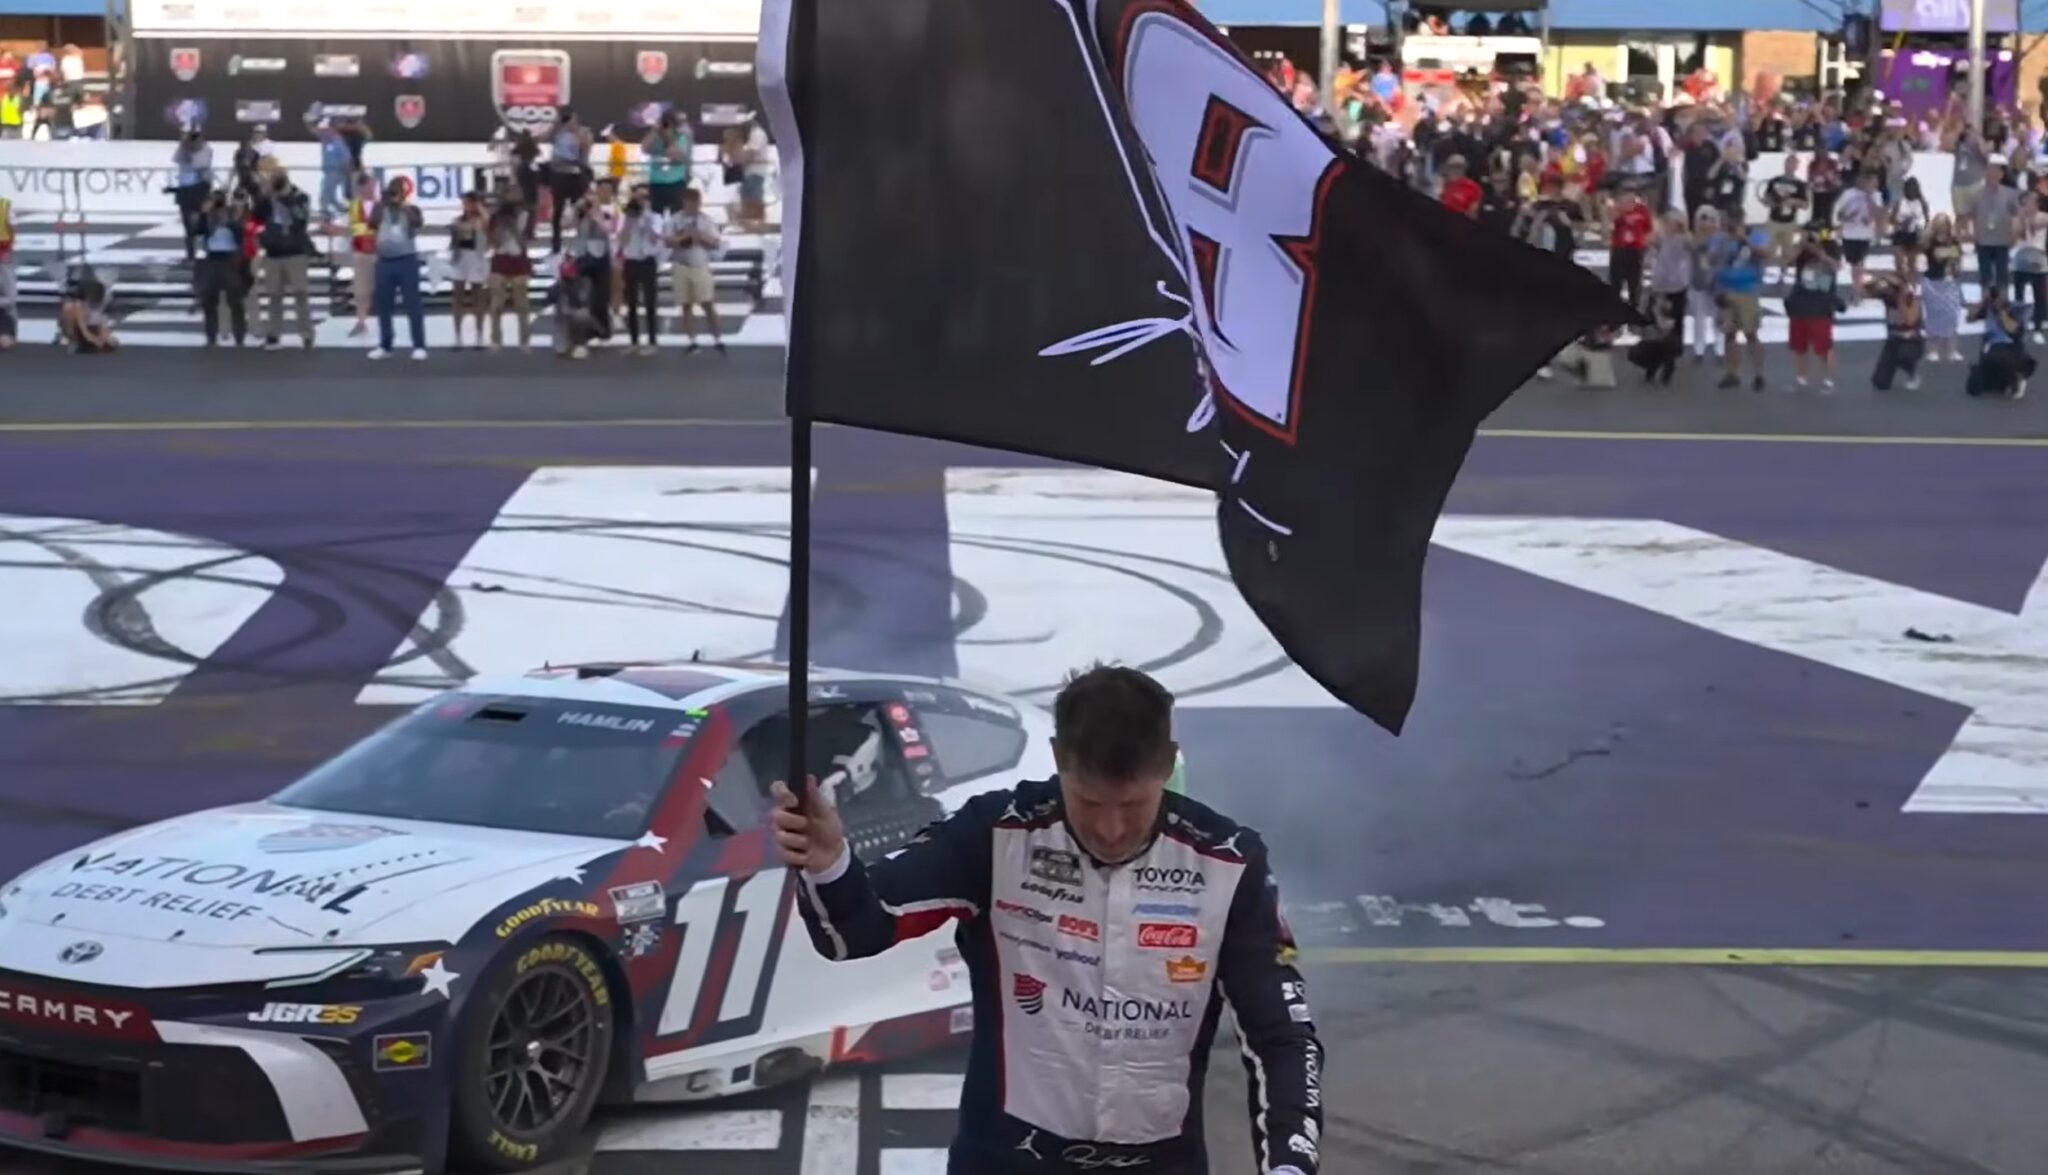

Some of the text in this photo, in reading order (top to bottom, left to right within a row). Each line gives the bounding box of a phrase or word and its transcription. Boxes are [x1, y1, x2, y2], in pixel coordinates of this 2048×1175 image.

[556, 711, 655, 732] HAMLIN
[1135, 867, 1207, 887] TOYOTA
[50, 881, 263, 921] DEBT RELIEF
[495, 897, 599, 938] GOODYEAR
[656, 867, 787, 1037] 11
[516, 942, 609, 1006] GOODYEAR
[1062, 987, 1193, 1021] NATIONAL
